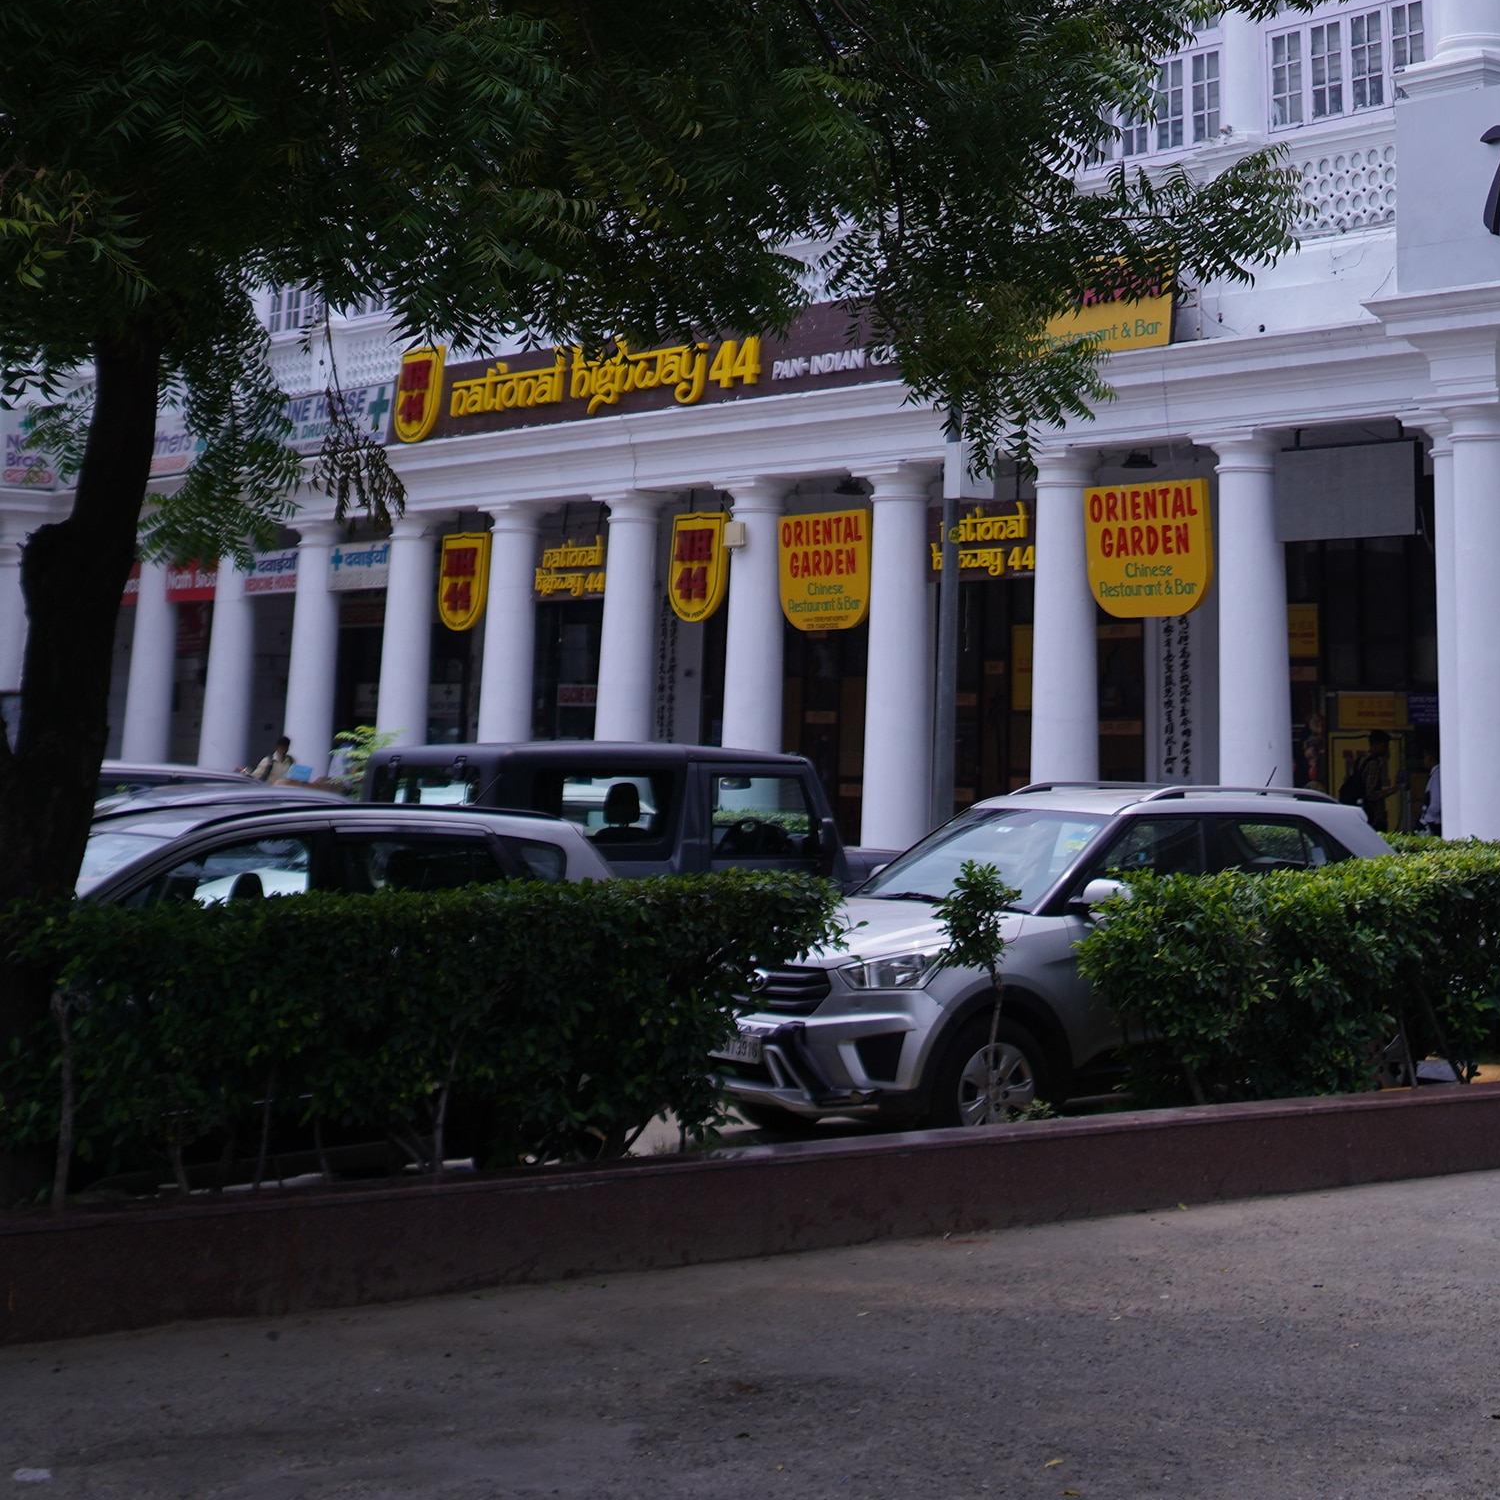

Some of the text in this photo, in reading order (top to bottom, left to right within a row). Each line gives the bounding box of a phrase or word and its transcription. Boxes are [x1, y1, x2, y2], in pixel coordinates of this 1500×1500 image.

[1120, 321, 1131, 337] &
[1134, 318, 1162, 338] Bar
[450, 346, 567, 417] national
[708, 336, 762, 389] 44
[397, 392, 426, 424] 44
[1089, 486, 1198, 524] ORIENTAL
[781, 515, 863, 549] ORIENTAL
[940, 501, 1030, 542] ational
[542, 535, 605, 568] national
[674, 528, 714, 562] NH
[1100, 522, 1190, 558] GARDEN
[790, 548, 857, 579] GARDEN
[1007, 545, 1035, 571] 44
[1124, 562, 1173, 579] Chinese
[442, 580, 472, 611] 44
[584, 572, 606, 593] 44
[675, 566, 707, 600] 44
[807, 582, 844, 596] Chinese
[1099, 578, 1198, 598] Restaurant & Bar
[788, 595, 862, 613] Restaurant & Bar
